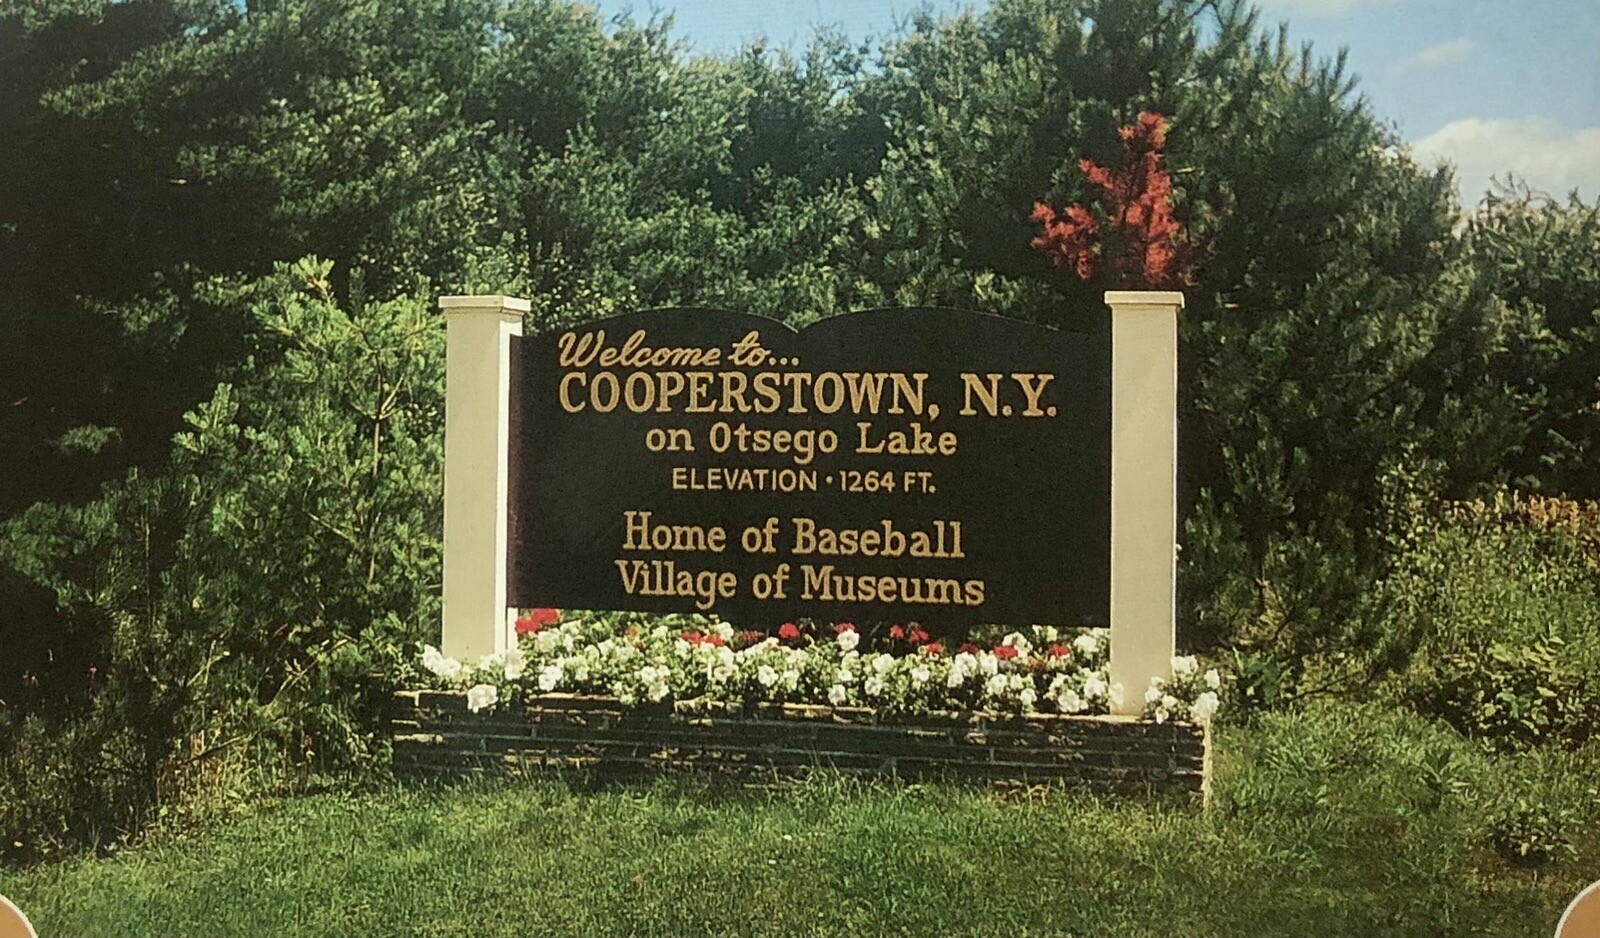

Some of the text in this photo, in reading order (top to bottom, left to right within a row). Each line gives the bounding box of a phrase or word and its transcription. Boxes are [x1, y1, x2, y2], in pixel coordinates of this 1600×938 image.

[558, 329, 721, 368] Welcome
[558, 371, 1057, 421] COOPERSTOWN, N.Y.
[645, 421, 958, 466] on Otsego Lake
[672, 467, 937, 494] ELEVATION 1264 FT.
[622, 510, 965, 558] Home of Baseball
[614, 559, 985, 610] Village of Museums
